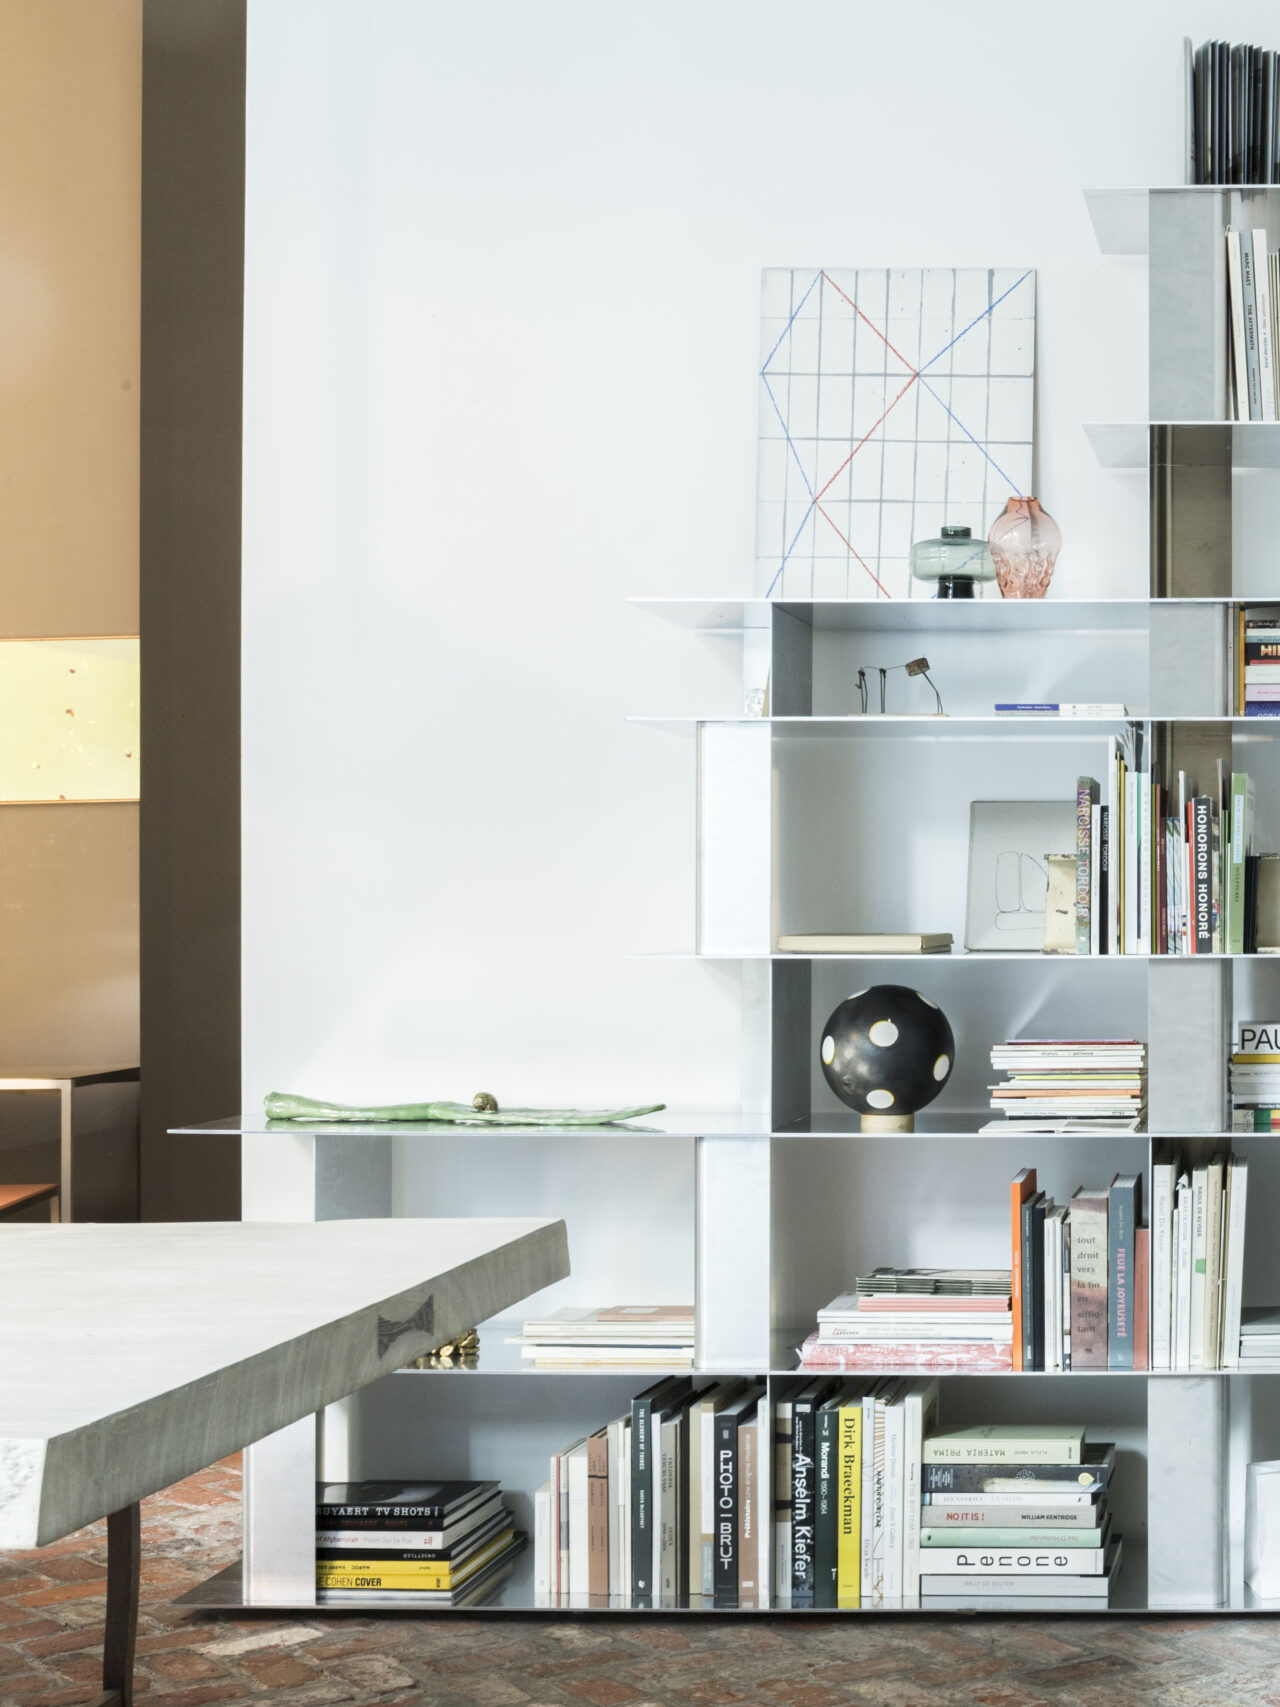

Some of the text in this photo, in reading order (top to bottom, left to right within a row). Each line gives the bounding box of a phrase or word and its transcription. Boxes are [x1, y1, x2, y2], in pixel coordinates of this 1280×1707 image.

[1247, 317, 1255, 351] AFTERMATH
[1077, 788, 1091, 917] NARCISSE TORDOIR
[1197, 805, 1211, 939] HONORONS HONORÉ
[1157, 1196, 1166, 1253] Raoul De Keyser
[1197, 1207, 1203, 1215] DE
[1077, 1251, 1099, 1259] droit
[1077, 1281, 1100, 1289] la fin
[1116, 1247, 1127, 1338] FEUE LA JOYEUSETÉ
[820, 1442, 830, 1479] Morandi
[843, 1417, 856, 1535] Dirk Braeckman
[794, 1453, 812, 1520] Anselm
[375, 1507, 390, 1516] TV
[393, 1507, 431, 1516] SHOTS
[719, 1449, 734, 1570] PHOTO BRUT
[946, 1513, 960, 1521] NO
[961, 1513, 969, 1521] IT
[970, 1513, 979, 1521] IS
[323, 1536, 359, 1544] Afghanistan
[794, 1525, 812, 1579] Kiefer
[956, 1554, 1069, 1567] Penone
[325, 1575, 354, 1587] COHEN
[355, 1575, 382, 1587] COVER
